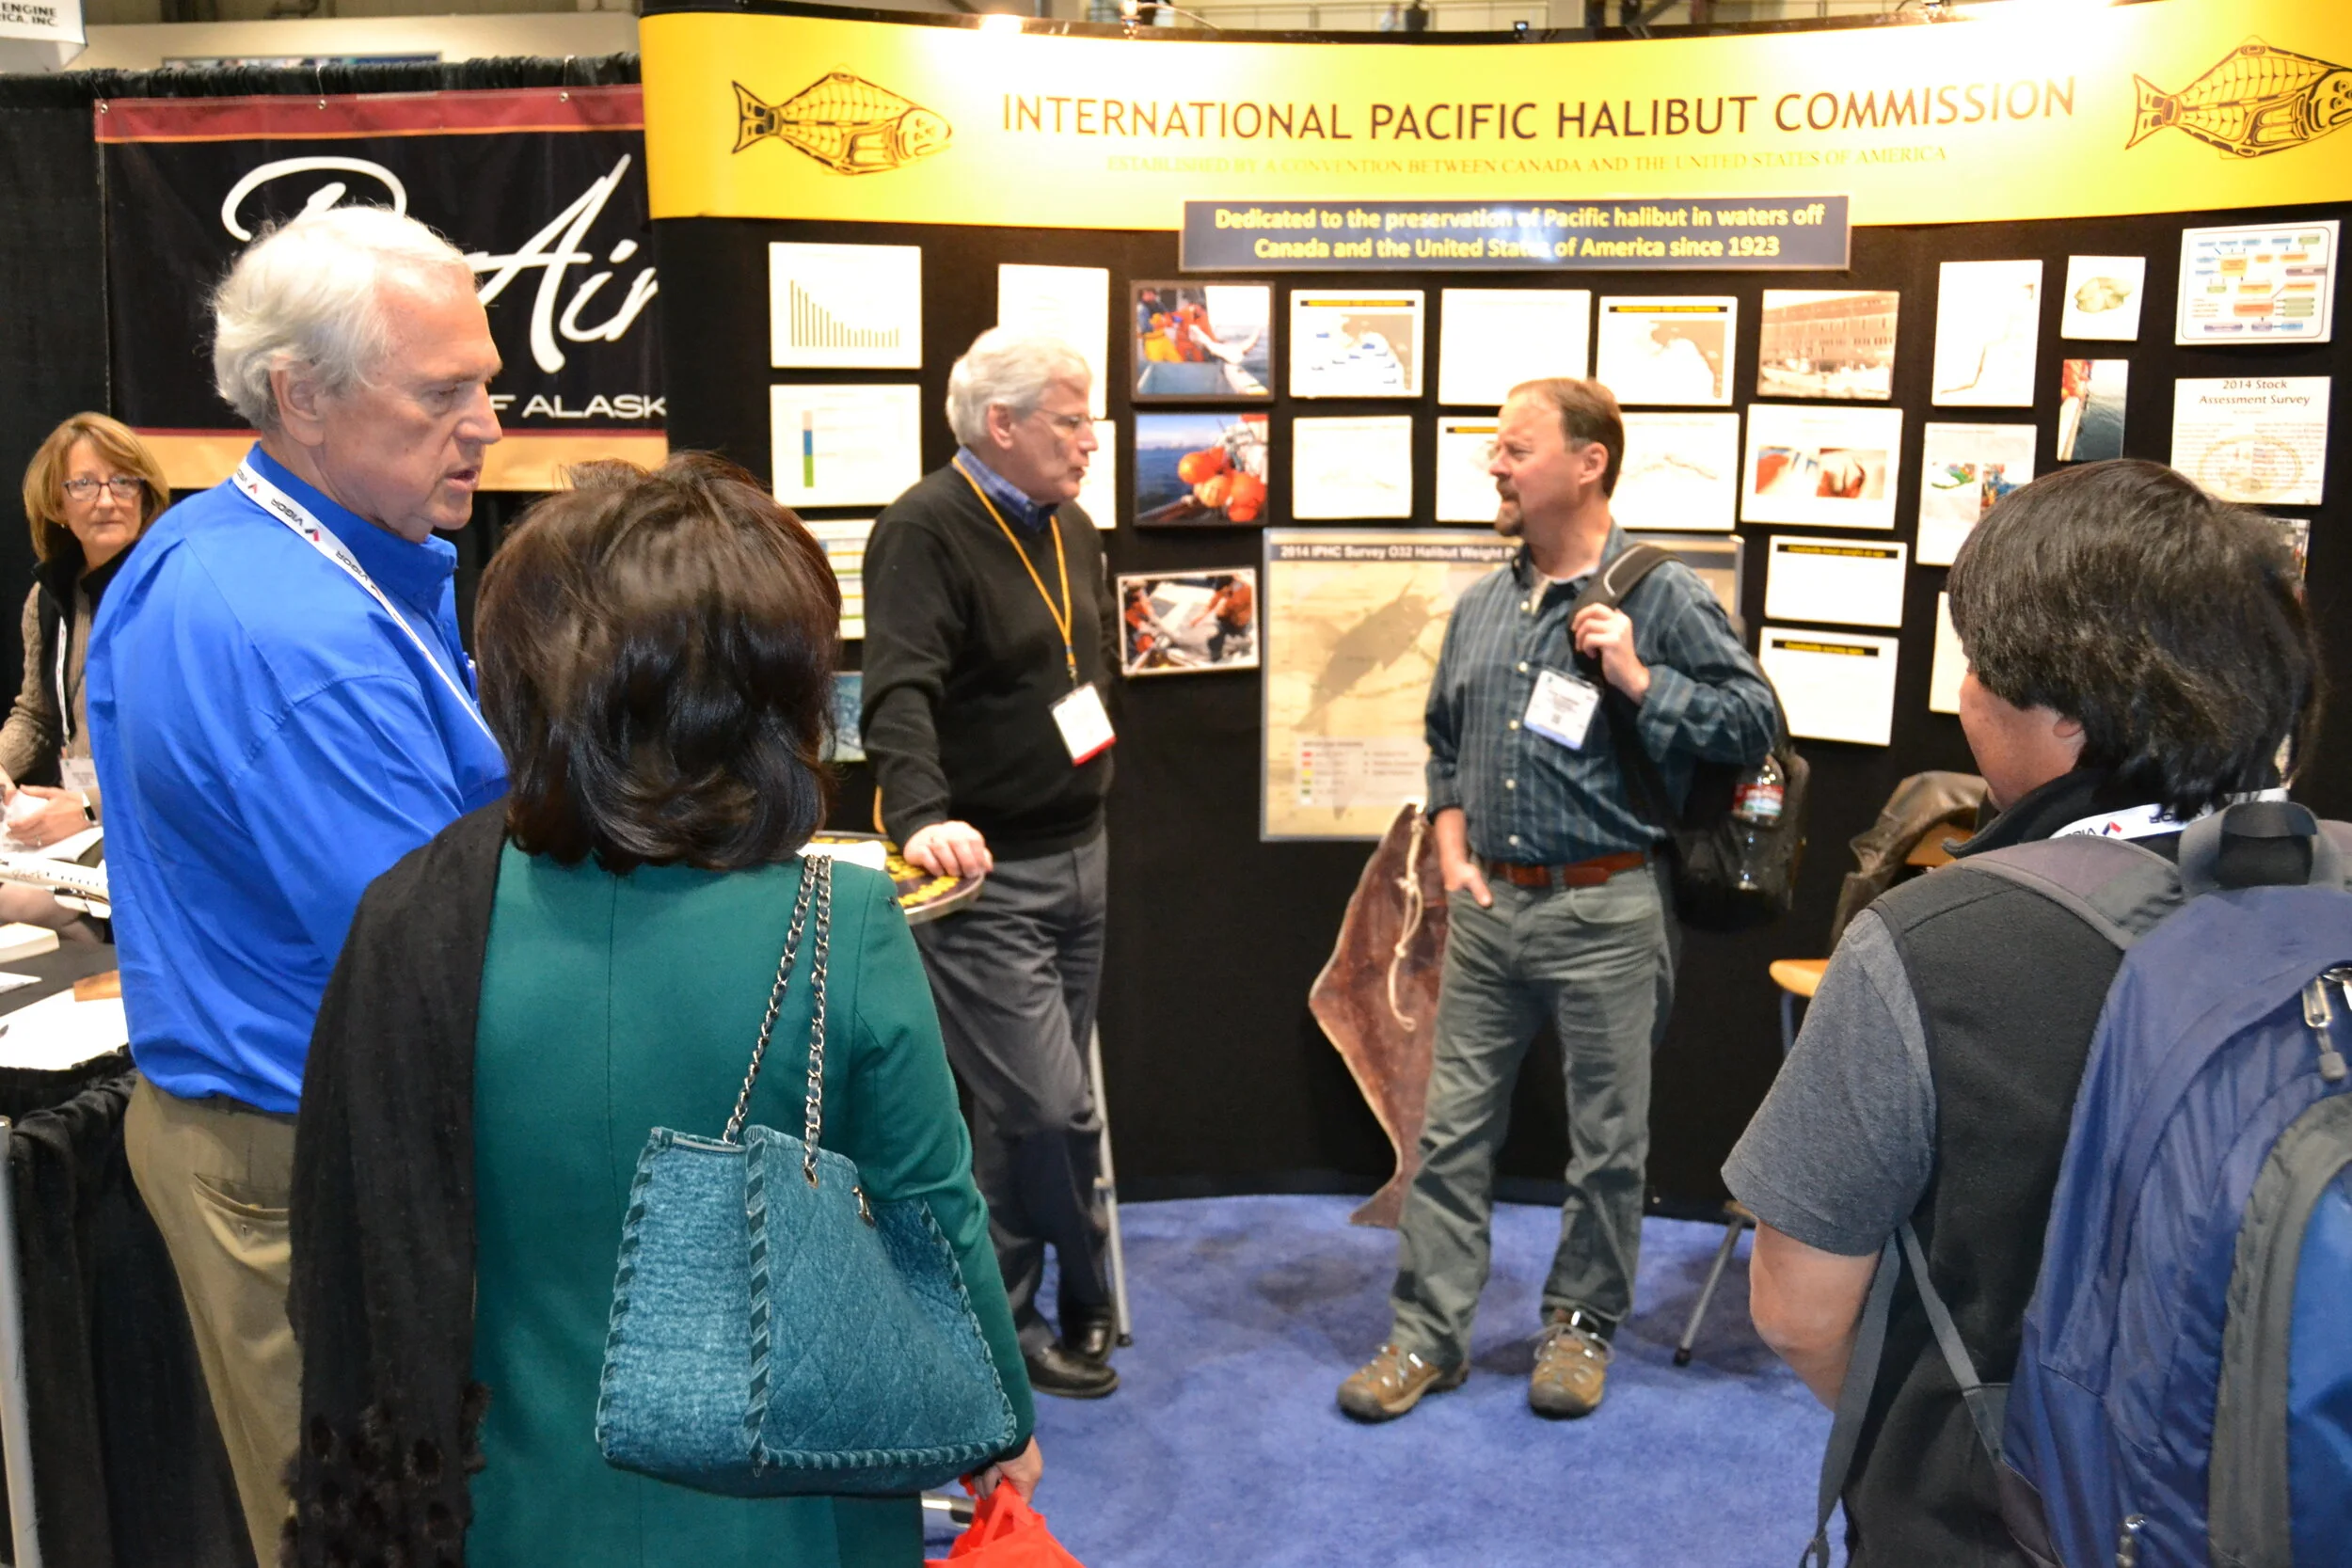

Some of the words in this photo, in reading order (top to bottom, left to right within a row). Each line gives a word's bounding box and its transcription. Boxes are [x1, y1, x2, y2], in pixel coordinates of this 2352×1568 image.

[0, 13, 28, 24] ICA,
[2, 3, 57, 17] ENGINE
[1003, 94, 1352, 139] INTERNATIONAL
[1371, 103, 1537, 140] PACIFIC
[1558, 96, 1757, 138] HALIBUT
[1775, 75, 2074, 132] COMMISSION
[1107, 156, 1231, 172] ESTABLISHED
[1280, 158, 1403, 173] CONVENTION
[1409, 159, 1497, 173] BETWEEN
[1502, 157, 1581, 174] CANADA
[1590, 156, 1628, 172] AND
[1635, 155, 1667, 170] THE
[1677, 154, 1747, 169] UNITED
[1753, 151, 1820, 167] STATES
[1825, 150, 1851, 166] OF
[1856, 146, 1947, 164] AMERICA
[1215, 209, 1316, 229] Dedicated
[1321, 211, 1343, 229] to
[1347, 209, 1381, 229] the
[1385, 207, 1513, 232] preservation
[1544, 206, 1610, 228] Pacific
[1613, 206, 1688, 227] halibut
[1692, 206, 1712, 226] in
[1717, 207, 1788, 226] waters
[1792, 203, 1825, 225] off
[1254, 238, 1329, 258] Canada
[1333, 238, 1372, 258] and
[1376, 238, 1410, 258] the
[1415, 238, 1484, 258] United
[1554, 236, 1578, 257] of
[1580, 237, 1665, 257] America
[1670, 236, 1724, 257] since
[1728, 235, 1780, 256] 1923
[2222, 380, 2251, 389] 2014
[2256, 379, 2287, 389] Stock
[522, 395, 667, 419] ALASK
[2199, 395, 2266, 404] Assessment
[2271, 394, 2311, 406] Survey
[271, 499, 304, 527] VIGOR
[1280, 546, 1309, 559] 2014
[1344, 546, 1386, 560] Survey
[336, 550, 369, 581] VIGOR
